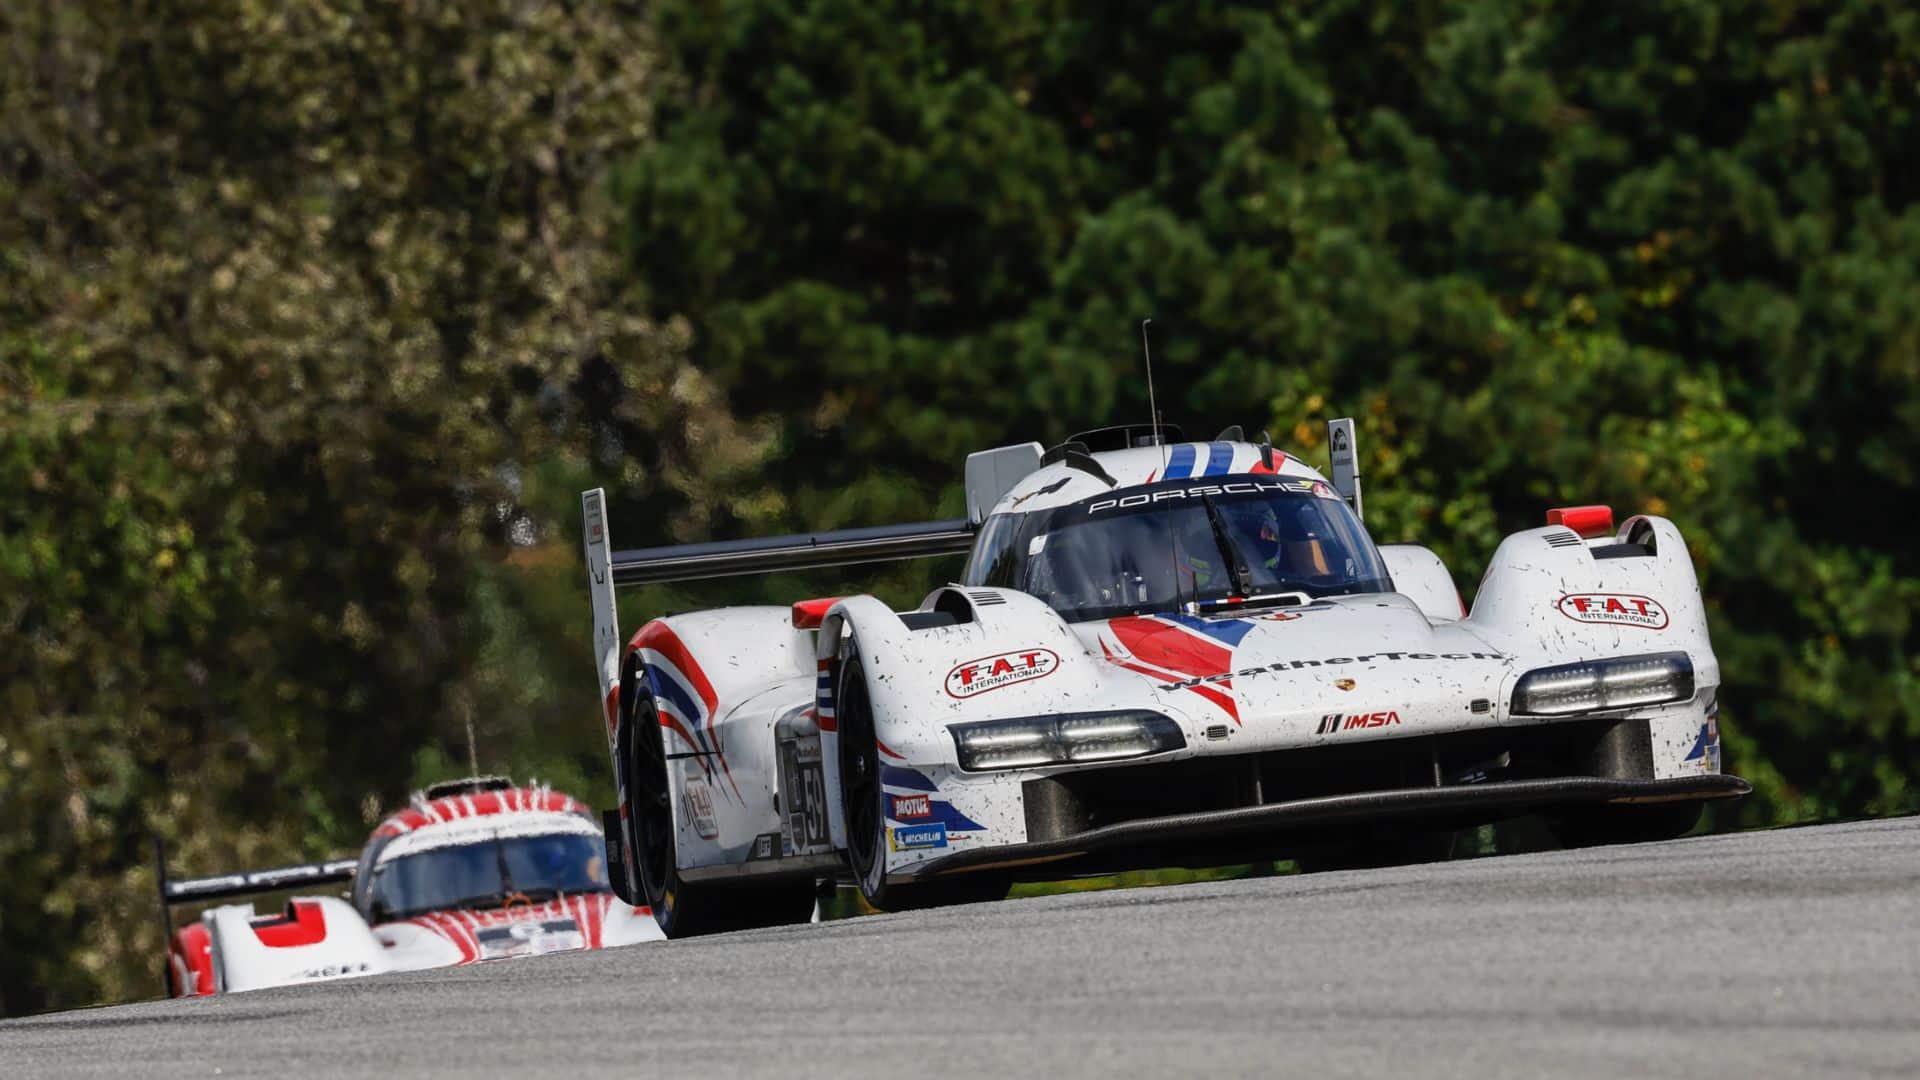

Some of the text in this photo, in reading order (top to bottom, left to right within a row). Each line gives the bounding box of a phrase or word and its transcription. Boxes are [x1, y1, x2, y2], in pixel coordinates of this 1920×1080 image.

[1088, 480, 1314, 514] PORSCHE
[1580, 612, 1659, 625] INTERNATIONAL
[963, 667, 1046, 694] INTERNATIONAL
[1157, 651, 1503, 692] WeatherTech
[1344, 711, 1401, 730] IMSA
[803, 767, 824, 841] 59
[896, 797, 929, 816] MOTUL
[905, 831, 941, 844] MICHELIN
